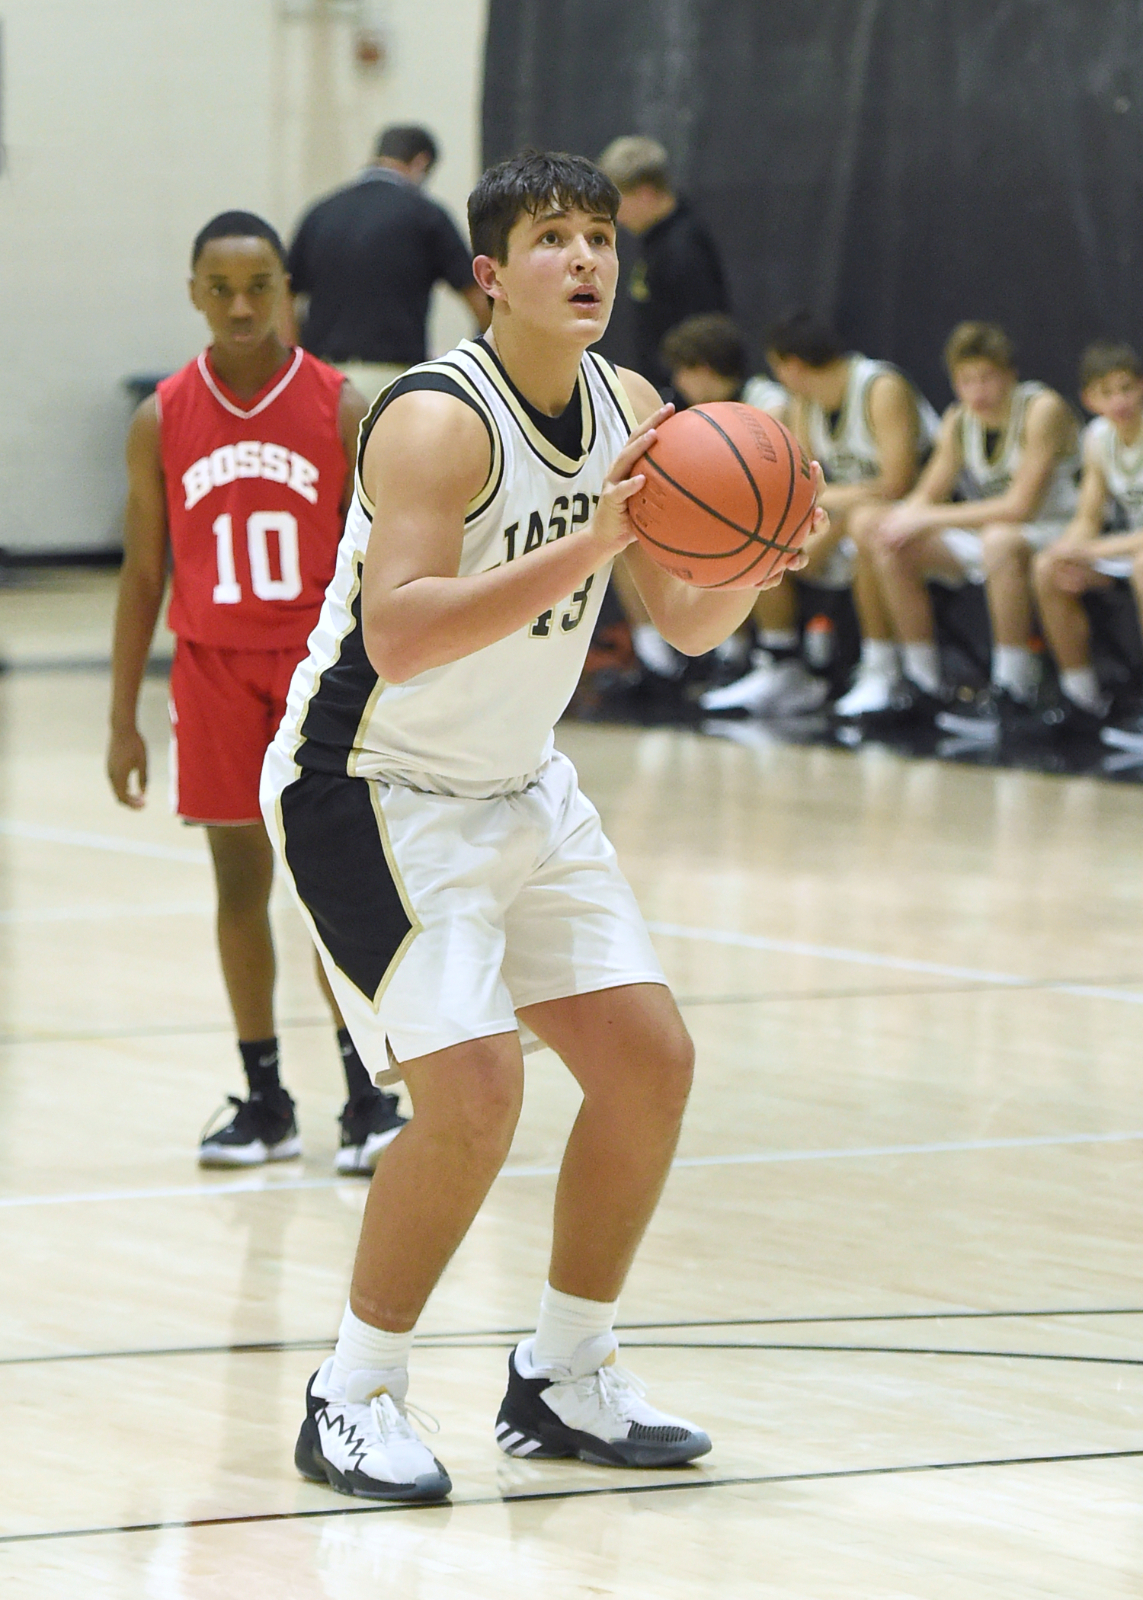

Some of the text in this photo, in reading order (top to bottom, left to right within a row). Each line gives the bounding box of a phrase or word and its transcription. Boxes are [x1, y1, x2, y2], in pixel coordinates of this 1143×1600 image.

[182, 440, 320, 511] BOSSE
[212, 510, 303, 604] 10
[484, 492, 600, 571] JASP
